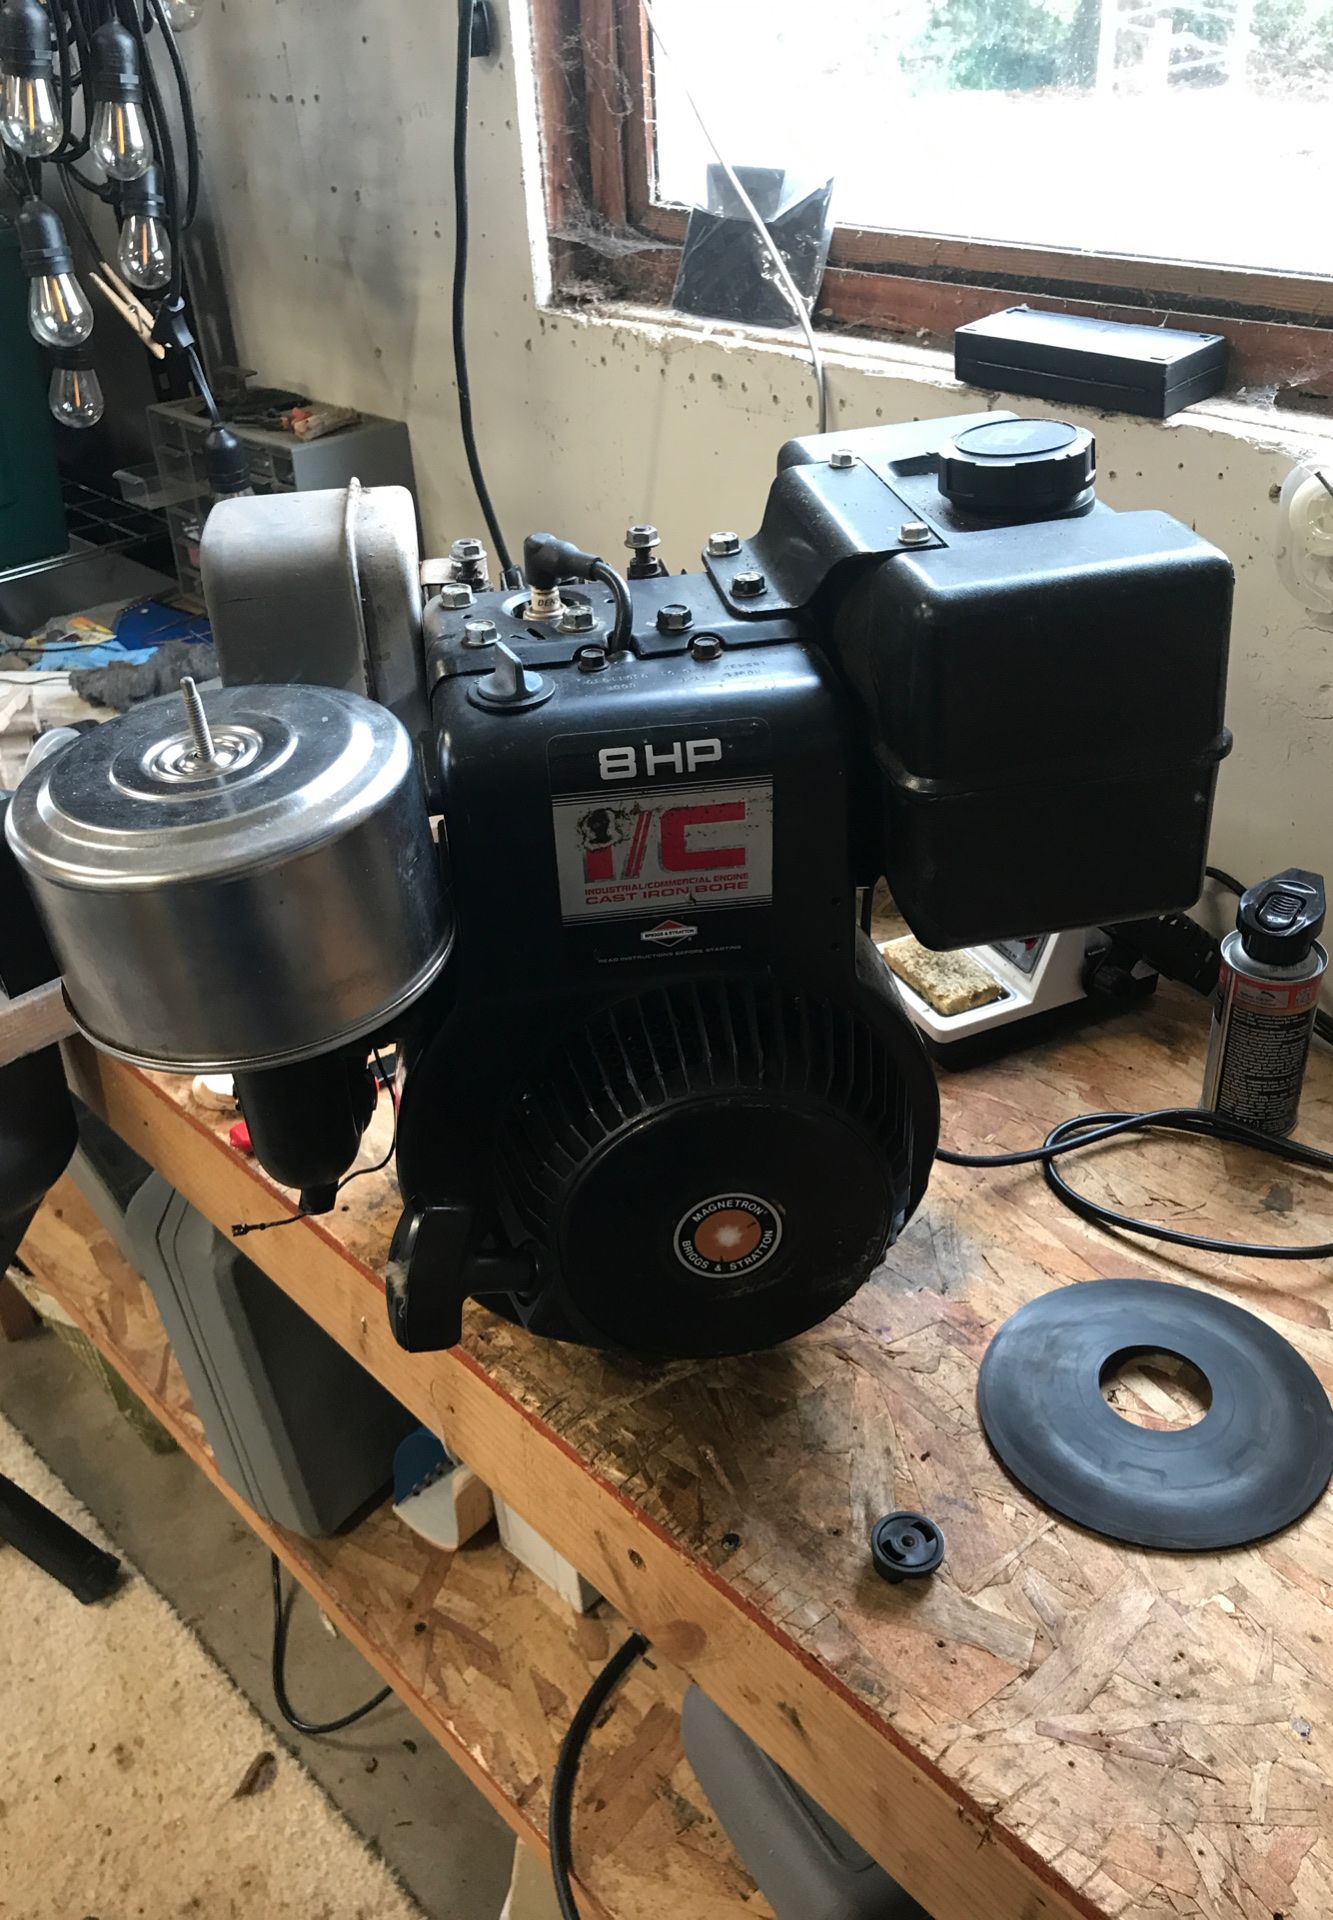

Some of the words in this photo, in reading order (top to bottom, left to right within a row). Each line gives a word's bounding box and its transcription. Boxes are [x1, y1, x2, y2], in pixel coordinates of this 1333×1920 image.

[585, 876, 711, 896] INDUSTRIAL/COMMERCIAL
[714, 872, 749, 882] ENGINE
[585, 892, 637, 905] CAST
[643, 888, 689, 899] IRON
[695, 881, 748, 893] BORE
[620, 951, 673, 961] INSTRUCTIONS
[675, 948, 703, 956] BEFORE
[706, 945, 742, 953] STARTING
[692, 1199, 764, 1222] MAGNETRON
[682, 1240, 710, 1269] BRIGGS
[714, 1264, 722, 1272] &
[730, 1230, 774, 1271] STRATTON
